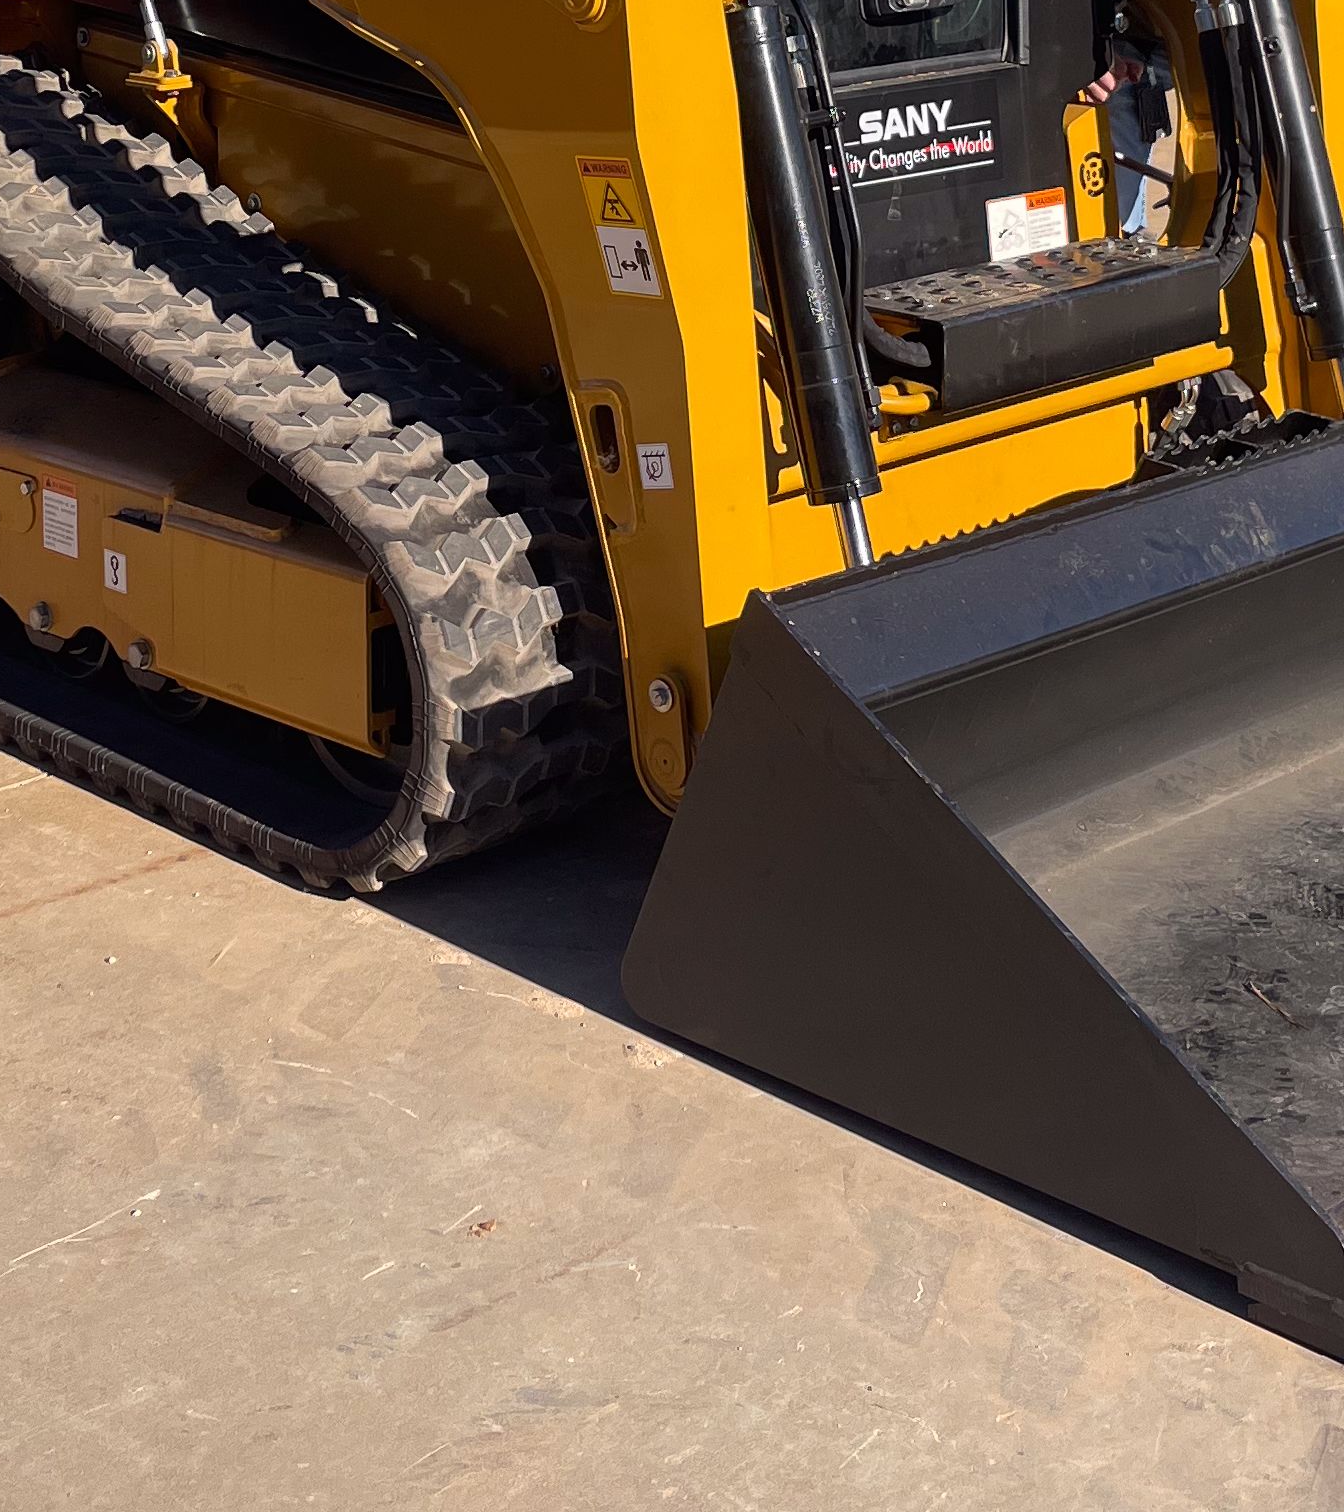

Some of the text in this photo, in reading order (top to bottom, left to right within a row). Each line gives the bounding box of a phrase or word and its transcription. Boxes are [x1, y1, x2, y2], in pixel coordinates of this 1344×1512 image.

[858, 99, 953, 144] SANY
[868, 147, 928, 170] Changes
[929, 138, 950, 161] the
[951, 129, 994, 155] World
